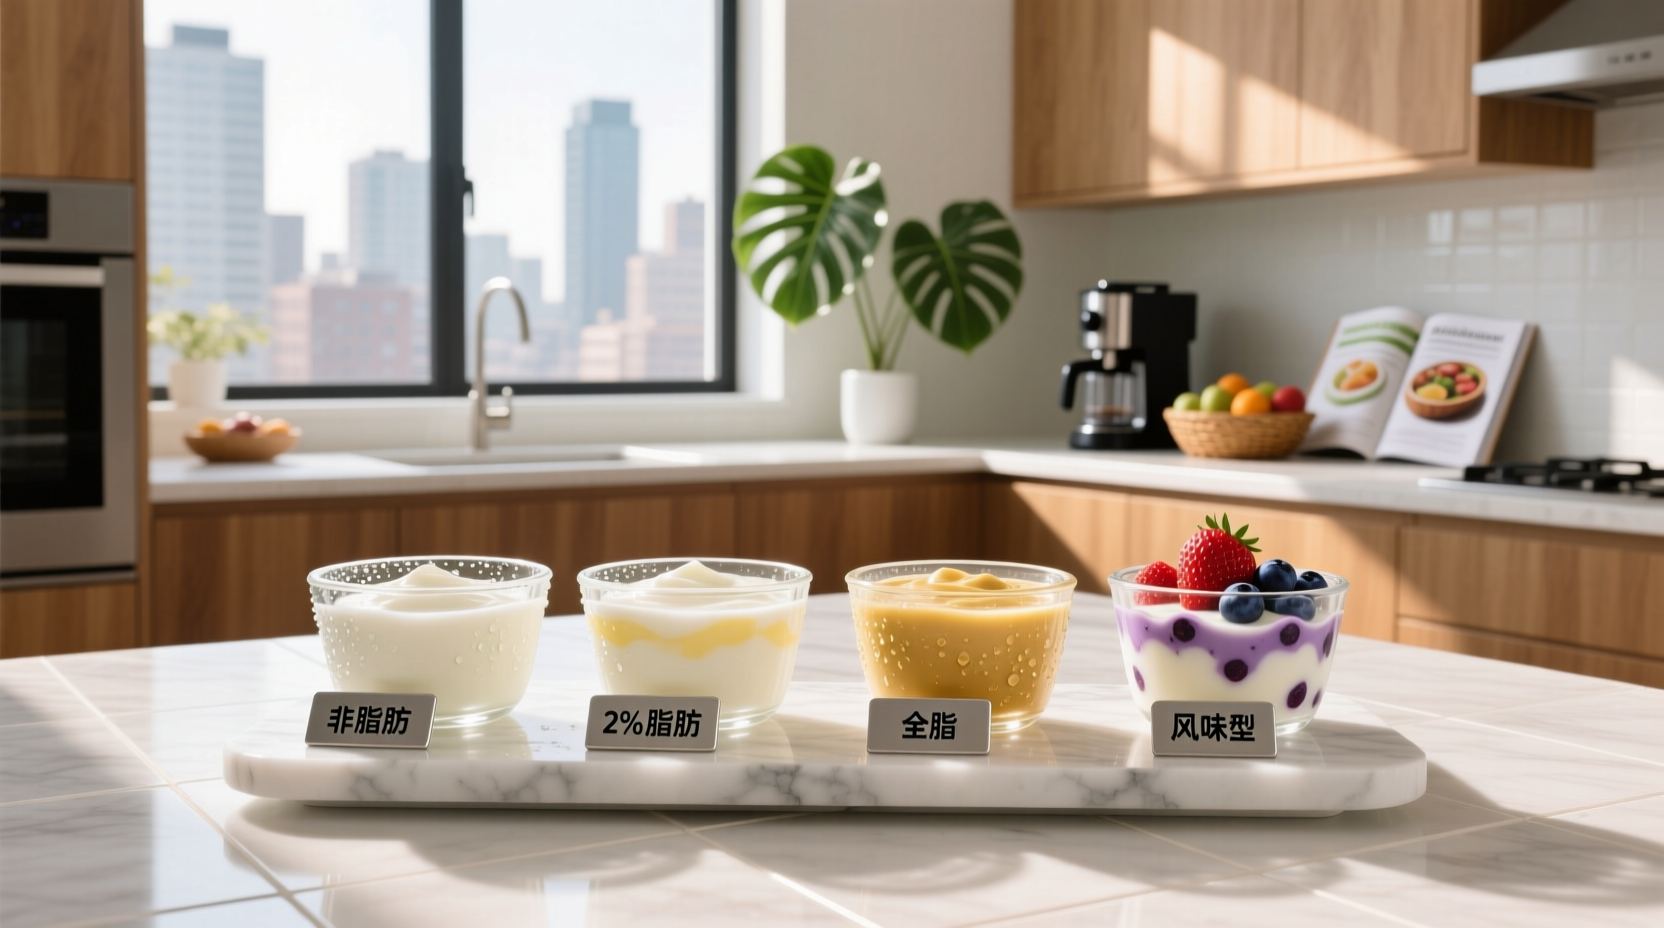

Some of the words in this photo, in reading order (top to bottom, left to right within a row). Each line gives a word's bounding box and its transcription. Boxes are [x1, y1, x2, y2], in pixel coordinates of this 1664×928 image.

[327, 706, 412, 735] 非脂肪
[603, 709, 702, 737] 2%脂肪
[902, 711, 957, 740] 全脂
[1171, 713, 1255, 742] 风味型
